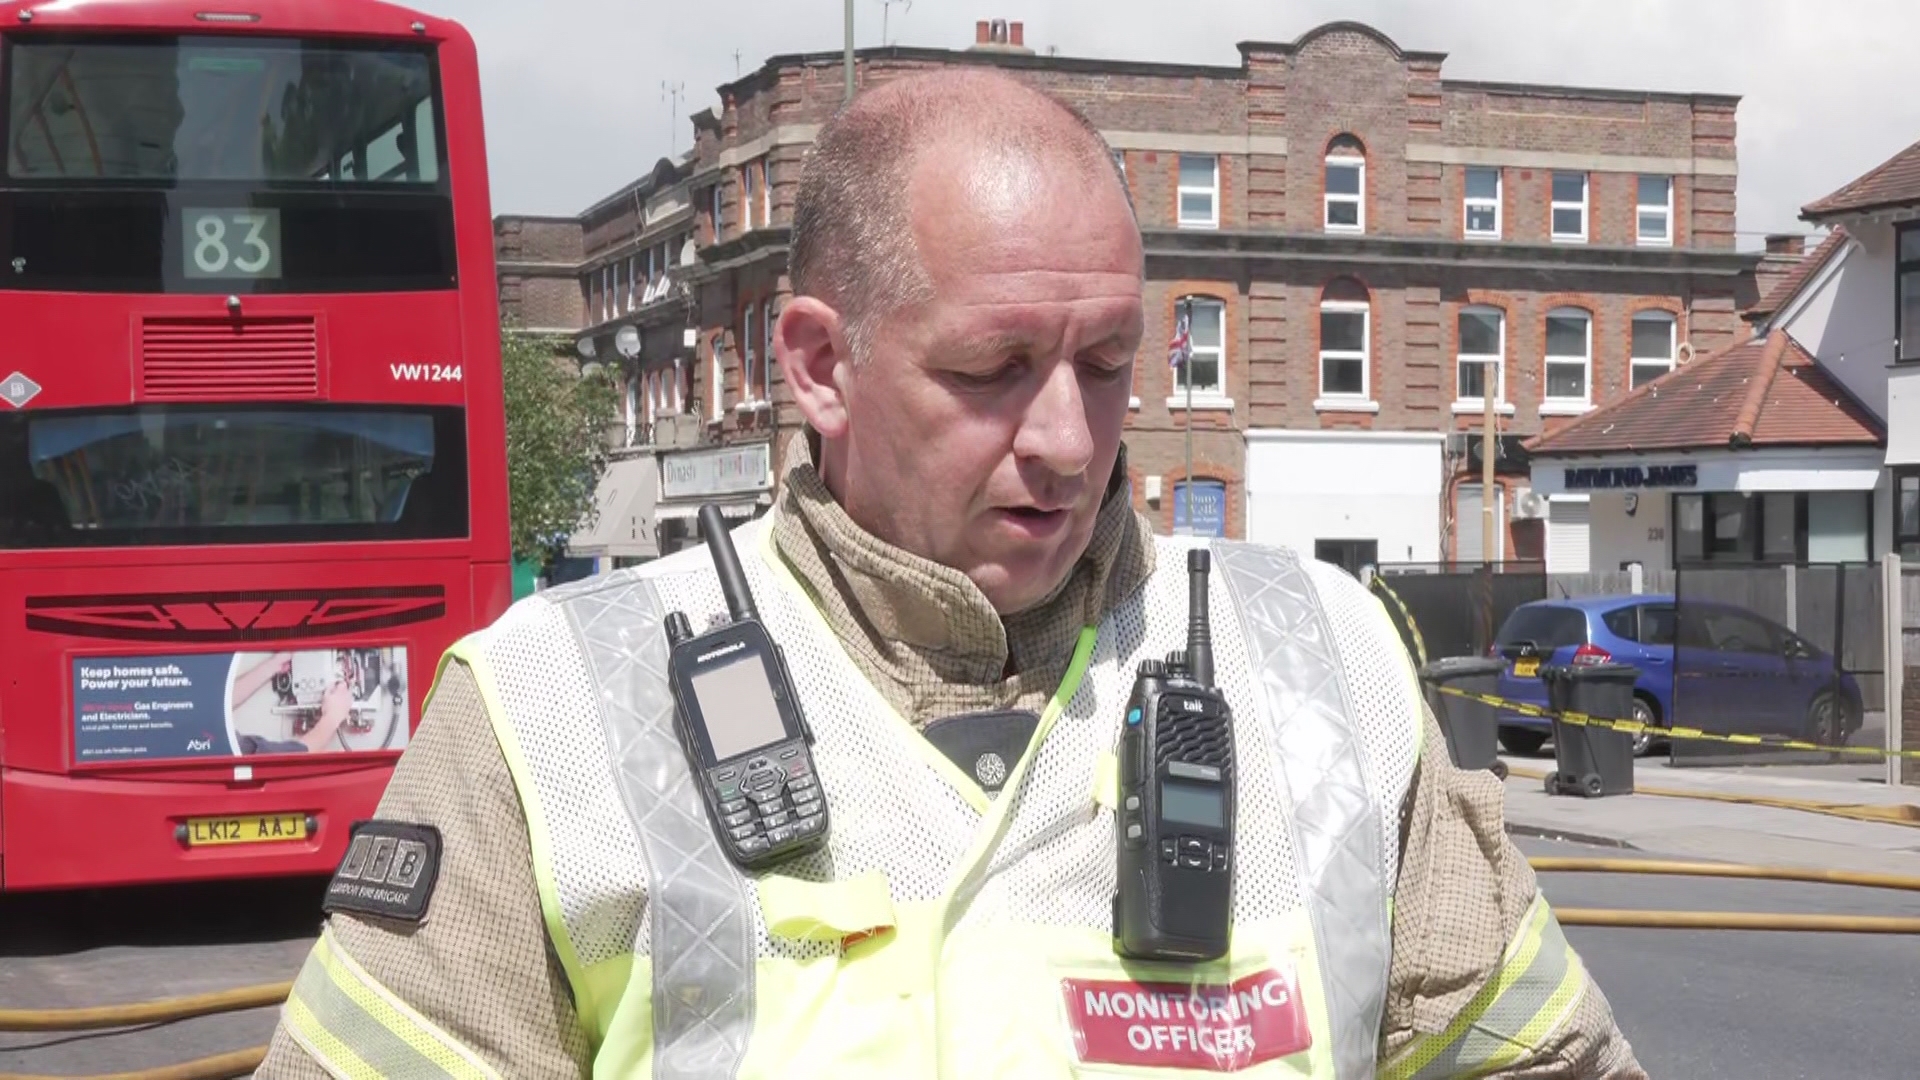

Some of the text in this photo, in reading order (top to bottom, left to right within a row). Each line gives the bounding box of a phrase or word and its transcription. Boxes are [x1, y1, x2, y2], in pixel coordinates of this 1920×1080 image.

[194, 215, 270, 273] 83
[390, 363, 463, 381] VW1244
[81, 664, 183, 679] Keep homes safe.
[81, 676, 192, 691] Power your future.
[134, 701, 150, 710] Gas
[152, 701, 193, 712] Engineers
[82, 712, 98, 721] and
[187, 739, 211, 751] Abri
[194, 817, 297, 841] LK12 AAJ
[1084, 979, 1288, 1022] MONITORING
[1127, 1024, 1256, 1057] OFFICER
